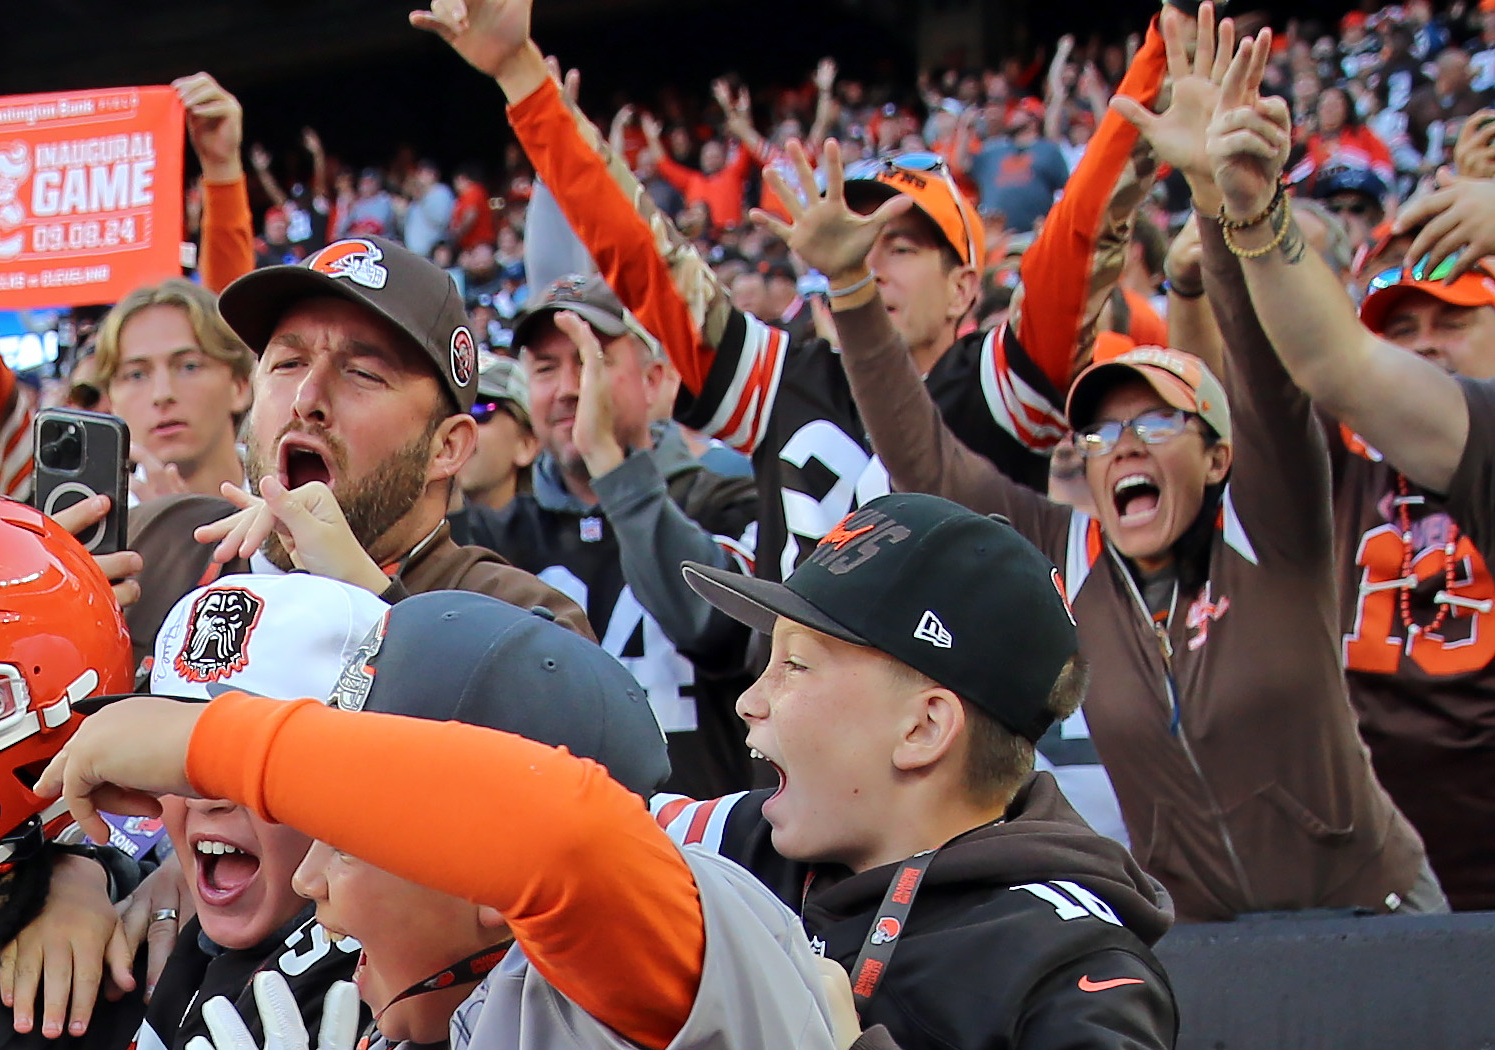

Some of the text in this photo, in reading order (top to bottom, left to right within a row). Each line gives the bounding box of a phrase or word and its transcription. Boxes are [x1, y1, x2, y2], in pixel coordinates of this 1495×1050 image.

[34, 132, 155, 168] INAUGURAL
[31, 159, 155, 216] GAME
[32, 216, 137, 252] 09.08.24
